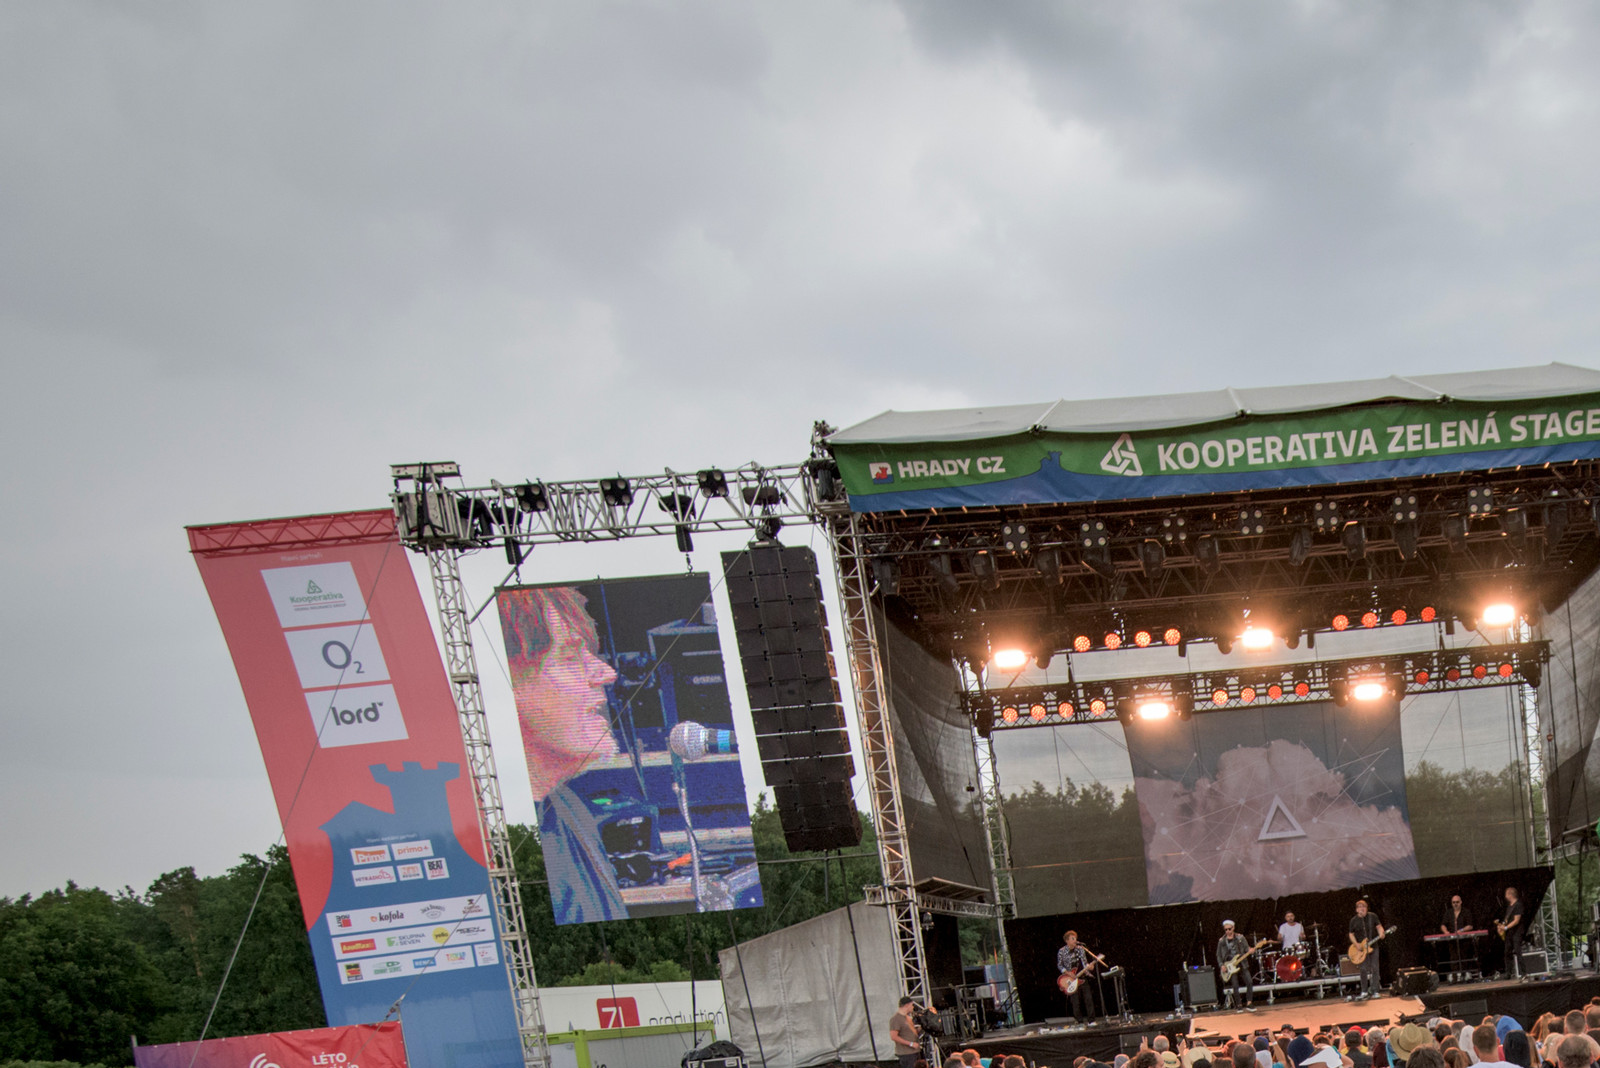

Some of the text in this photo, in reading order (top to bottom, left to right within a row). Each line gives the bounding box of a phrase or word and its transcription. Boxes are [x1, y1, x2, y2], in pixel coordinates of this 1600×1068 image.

[1158, 428, 1378, 472] KOOPERATIVA
[1386, 410, 1500, 453] ZELENÁ
[897, 456, 1006, 479] HRADY CZ
[289, 592, 344, 604] Kooperativa
[321, 640, 365, 674] O2
[331, 702, 381, 726] lord
[427, 860, 443, 870] BEAT
[379, 910, 405, 923] kofola
[398, 933, 426, 941] SKUPINA
[312, 1052, 347, 1066] LÉTO
